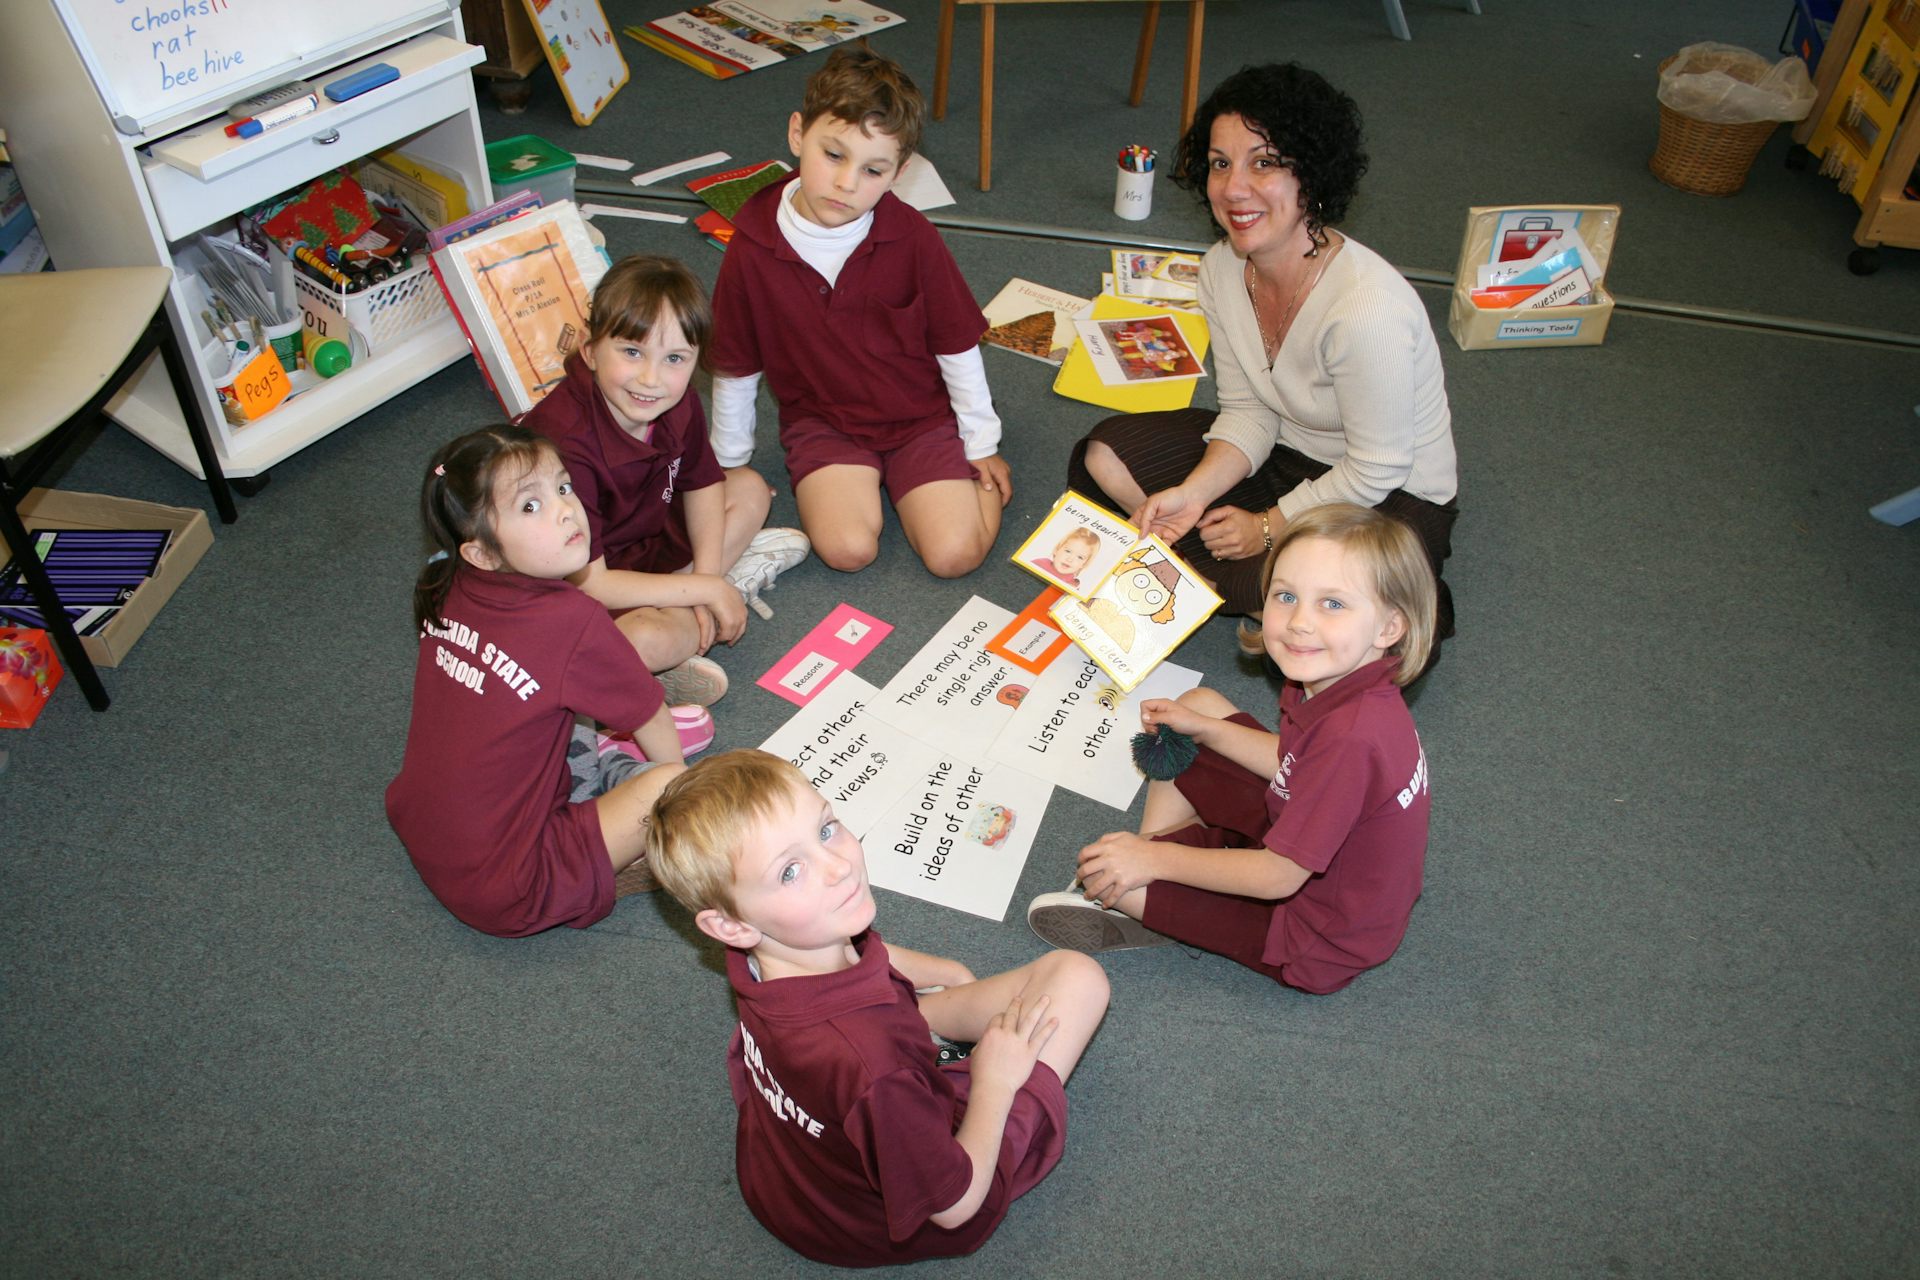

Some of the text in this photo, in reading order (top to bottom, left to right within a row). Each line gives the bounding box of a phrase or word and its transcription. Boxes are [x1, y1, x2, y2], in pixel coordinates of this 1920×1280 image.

[131, 0, 210, 32] chooks
[152, 24, 197, 59] rat
[1122, 190, 1144, 202] Mrs
[512, 282, 532, 296] Class
[1504, 323, 1574, 335] Thinking Tools
[1064, 505, 1135, 548] being beautiful
[896, 620, 988, 707] There may be no
[1019, 630, 1046, 655] Examples
[1064, 610, 1134, 675] being clever
[435, 645, 486, 695] SCHOOL
[481, 642, 541, 702] STATE
[792, 661, 825, 688] Reasons
[937, 649, 994, 707] single righ
[1028, 708, 1070, 753] Listen
[1060, 691, 1080, 706] to
[829, 733, 869, 767] their
[894, 761, 952, 856] Build on the
[919, 766, 984, 881] ideas of other
